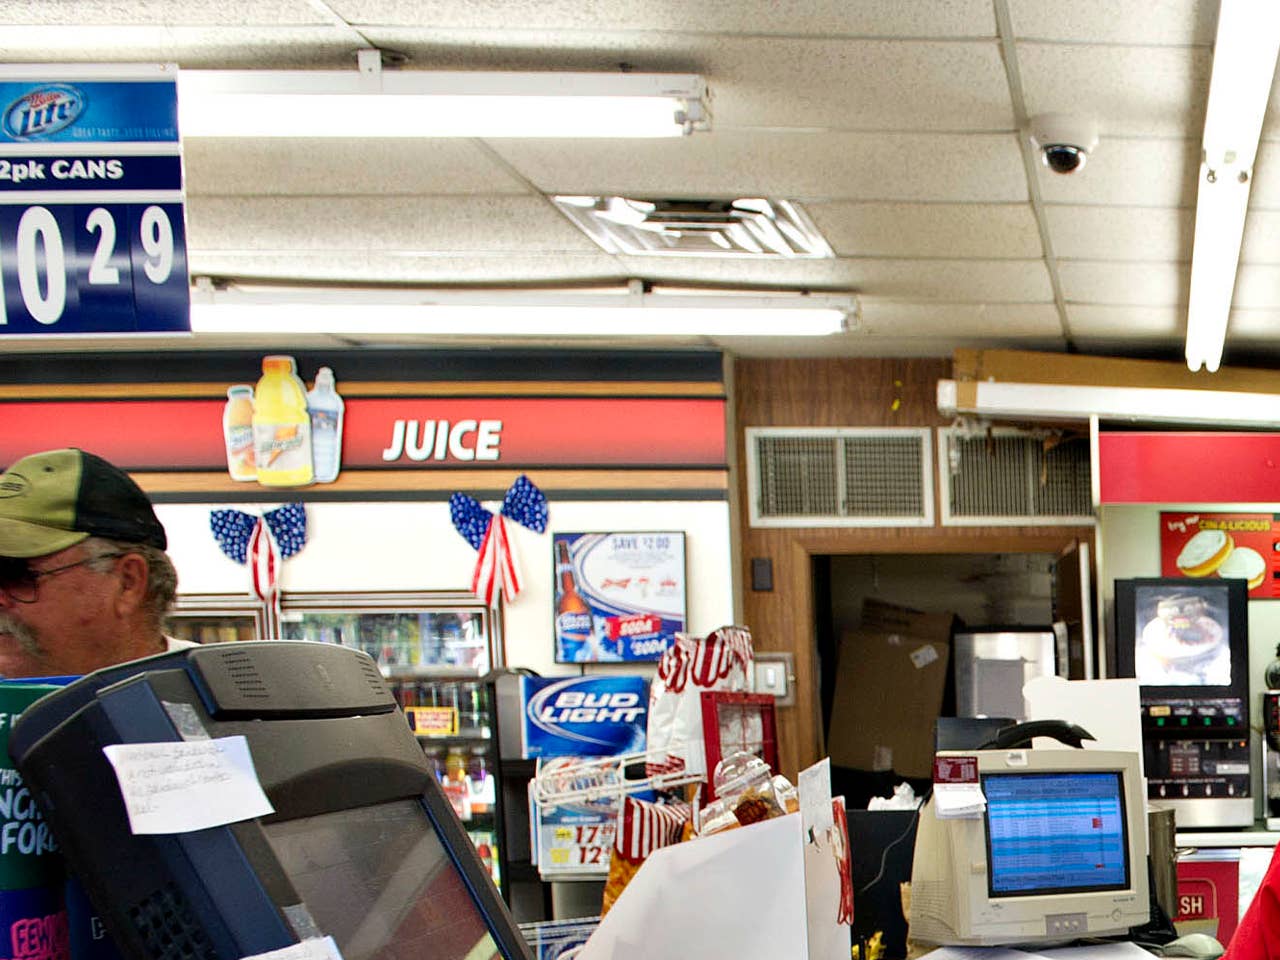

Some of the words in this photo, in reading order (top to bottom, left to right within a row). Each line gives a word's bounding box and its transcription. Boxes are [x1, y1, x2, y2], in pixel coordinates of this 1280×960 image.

[51, 159, 124, 179] CANS
[383, 419, 503, 461] JUICE
[554, 691, 640, 709] BUD
[539, 705, 647, 724] LIGHT
